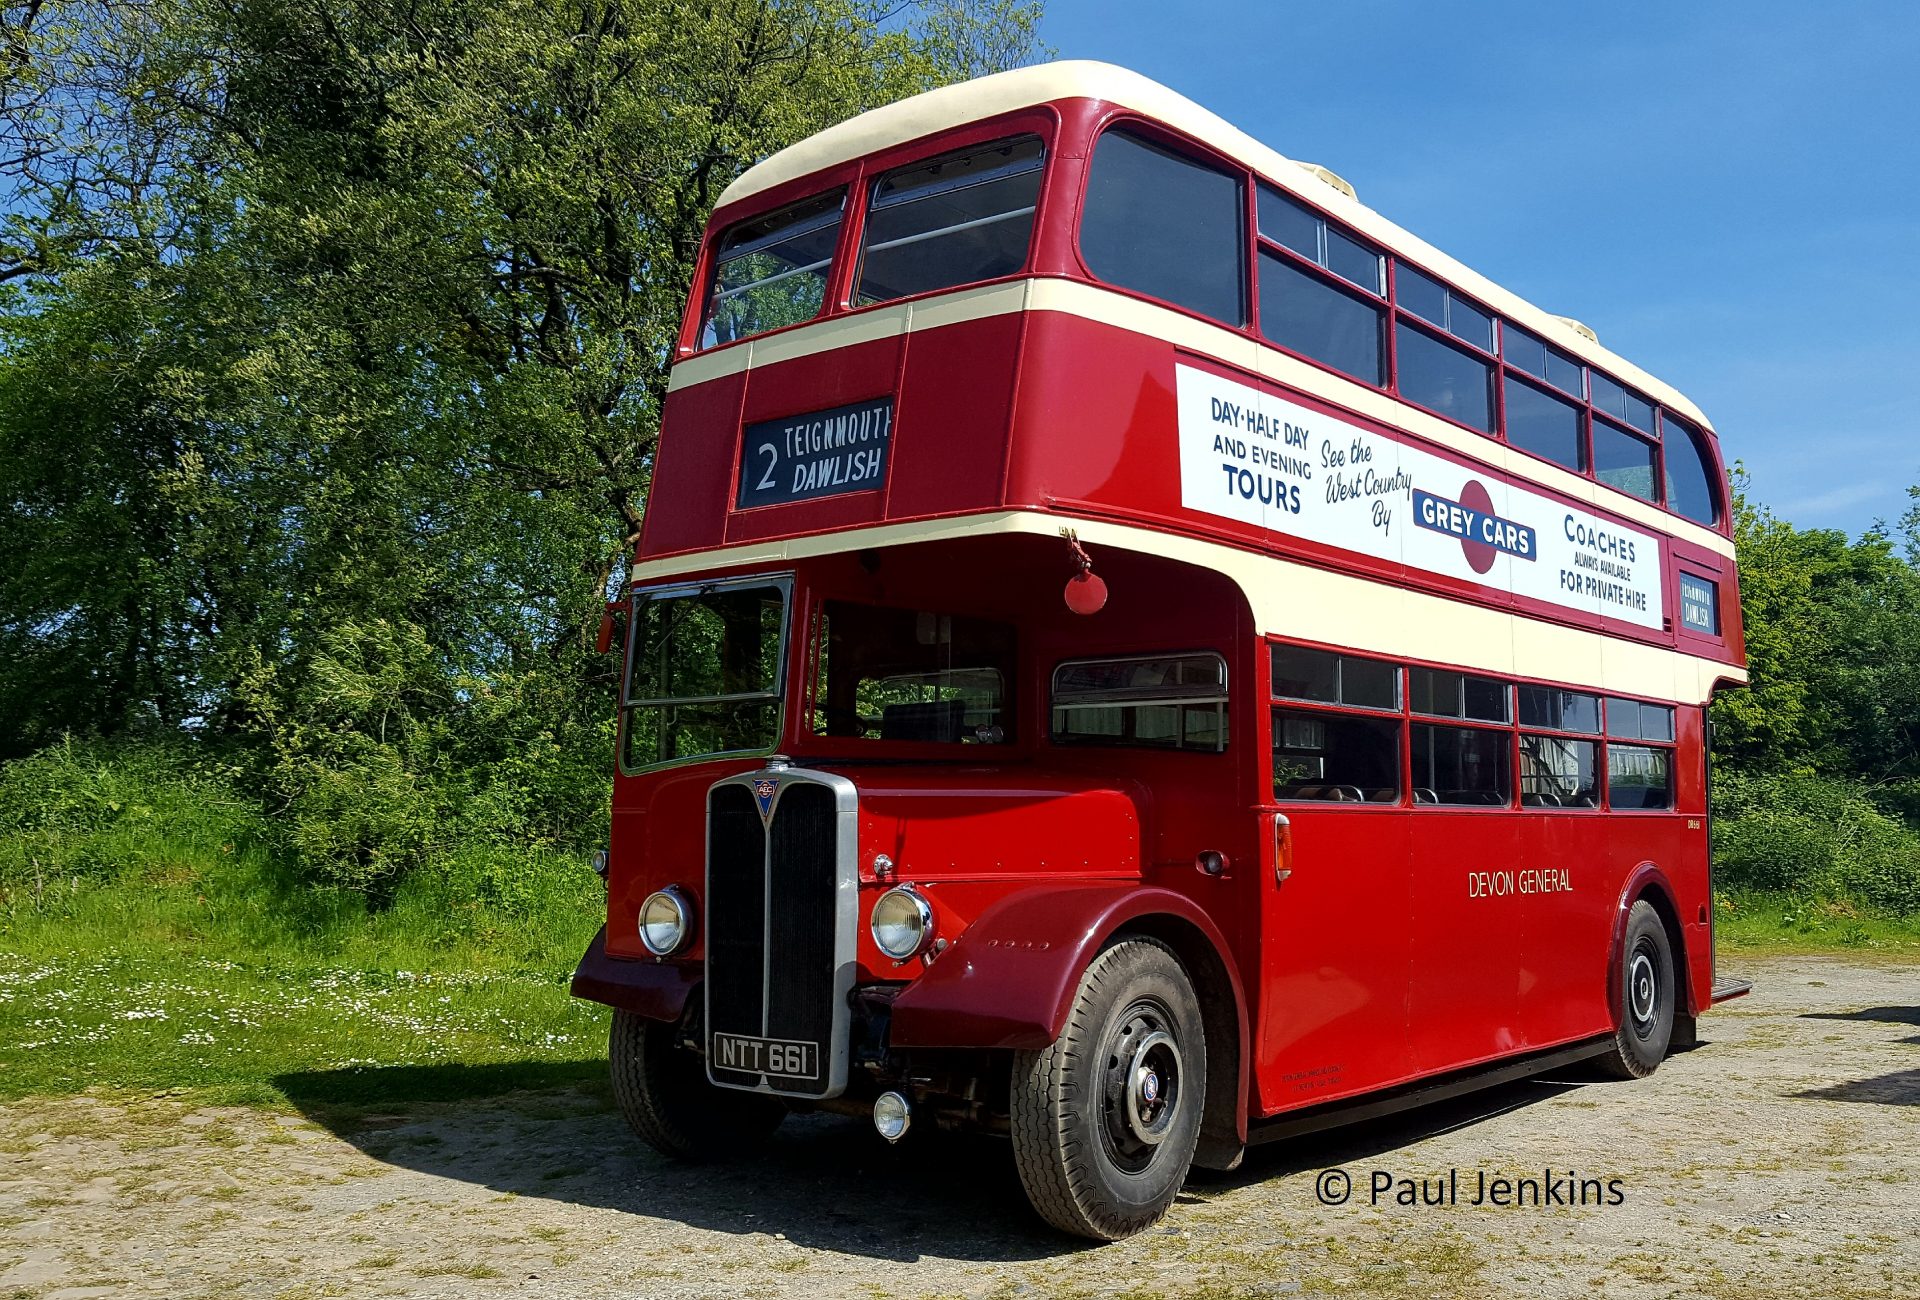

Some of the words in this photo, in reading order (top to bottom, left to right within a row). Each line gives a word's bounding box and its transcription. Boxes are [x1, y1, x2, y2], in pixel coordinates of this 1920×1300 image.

[1284, 422, 1309, 450] DAY
[1321, 439, 1345, 468] See
[1350, 437, 1372, 465] the
[755, 442, 778, 491] 2
[791, 447, 882, 493] DAWLISH
[1213, 434, 1246, 459] AND
[1252, 445, 1312, 480] EVENING
[1222, 463, 1301, 514] TOURS
[1325, 473, 1362, 504] West
[1364, 466, 1412, 501] Country
[1371, 500, 1391, 537] By
[1422, 497, 1474, 536] GREY
[1482, 517, 1529, 554] CARS
[1563, 514, 1636, 563] COACHES
[1574, 551, 1599, 572] ALWAYS
[1600, 560, 1631, 582] AVAILABLE
[1560, 569, 1583, 594] FOR
[1585, 576, 1623, 605] PRIVATE
[1625, 588, 1646, 611] HIRE
[1468, 870, 1514, 898] DEVON
[1518, 868, 1573, 894] GENERAL
[722, 1037, 763, 1068] NTT
[769, 1043, 807, 1073] 661
